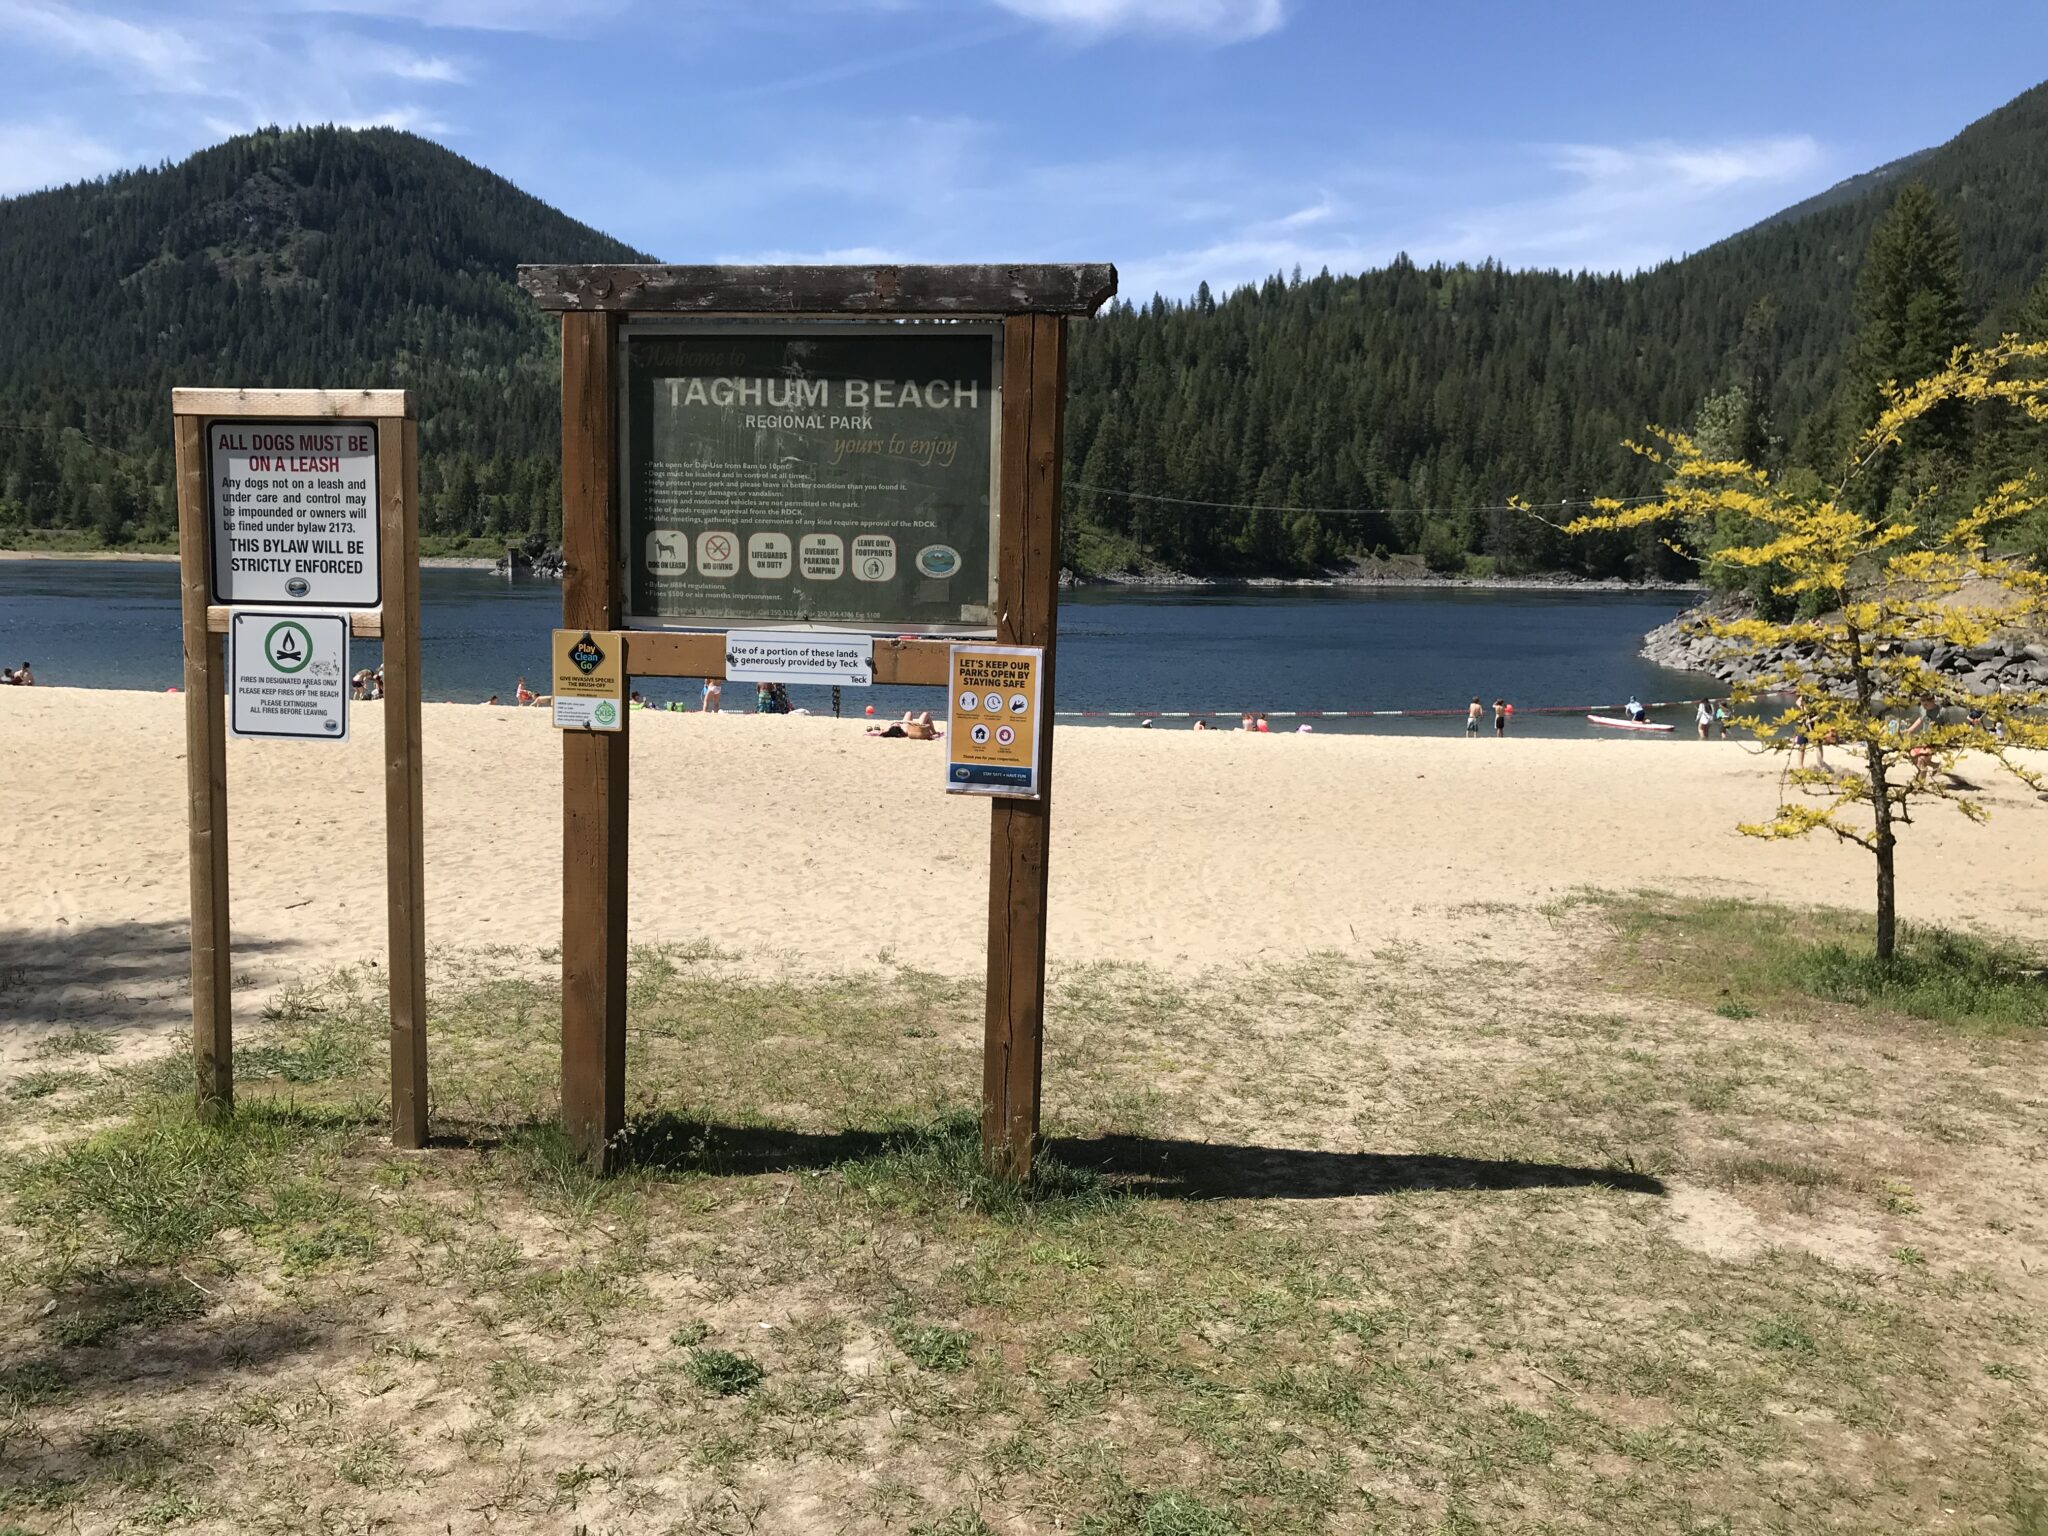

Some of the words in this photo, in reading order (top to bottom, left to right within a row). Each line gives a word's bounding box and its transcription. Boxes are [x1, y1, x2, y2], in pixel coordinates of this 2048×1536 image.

[665, 378, 828, 407] TAGHUM
[846, 379, 978, 408] BEACH
[746, 415, 824, 429] REGIONAL
[831, 416, 872, 429] PARK
[219, 434, 247, 450] ALL
[252, 434, 294, 450] DOGS
[300, 435, 343, 451] MUST
[348, 436, 368, 452] BE
[828, 436, 884, 464] yours
[889, 434, 905, 454] to
[911, 436, 958, 467] enjoy
[250, 456, 270, 472] ON
[275, 456, 286, 472] A
[290, 456, 340, 472] LEASH
[695, 461, 722, 470] Day-Use
[222, 478, 240, 490] Any
[244, 478, 268, 490] dogs
[272, 479, 288, 488] not
[292, 480, 304, 489] on
[308, 481, 314, 489] a
[318, 478, 344, 489] leash
[348, 479, 366, 490] and
[222, 492, 251, 502] under
[256, 494, 278, 503] care
[282, 493, 301, 503] and
[306, 494, 340, 504] control
[346, 496, 366, 506] may
[223, 506, 235, 516] be
[238, 506, 293, 519] impounded
[296, 510, 306, 518] or
[310, 510, 346, 518] owners
[349, 508, 366, 519] will
[224, 520, 236, 531] be
[238, 520, 263, 532] fined
[266, 522, 294, 532] under
[298, 522, 326, 534] bylaw
[329, 522, 356, 533] 2173.
[230, 538, 259, 552] THIS
[264, 540, 308, 553] BYLAW
[312, 540, 343, 554] WILL
[348, 541, 364, 554] BE
[805, 548, 838, 556] OVERNIGHT
[856, 549, 892, 557] FOOTPRINTS
[232, 558, 291, 572] STRICTLY
[296, 560, 363, 574] ENFORCED
[808, 566, 836, 574] CAMPING
[579, 643, 596, 654] Play
[749, 646, 759, 654] of
[767, 648, 798, 659] portion
[837, 650, 858, 658] lands
[575, 652, 598, 661] Clean
[741, 657, 786, 666] generously
[788, 658, 825, 667] provided
[827, 659, 837, 668] by
[840, 660, 858, 668] Teck
[581, 661, 592, 669] Go
[960, 659, 983, 668] LET'S
[986, 661, 1008, 669] KEEP
[1010, 662, 1030, 670] OUR
[960, 668, 988, 677] PARKS
[991, 670, 1015, 678] OPEN
[963, 678, 1000, 686] STAYING
[1003, 680, 1025, 688] SAFE
